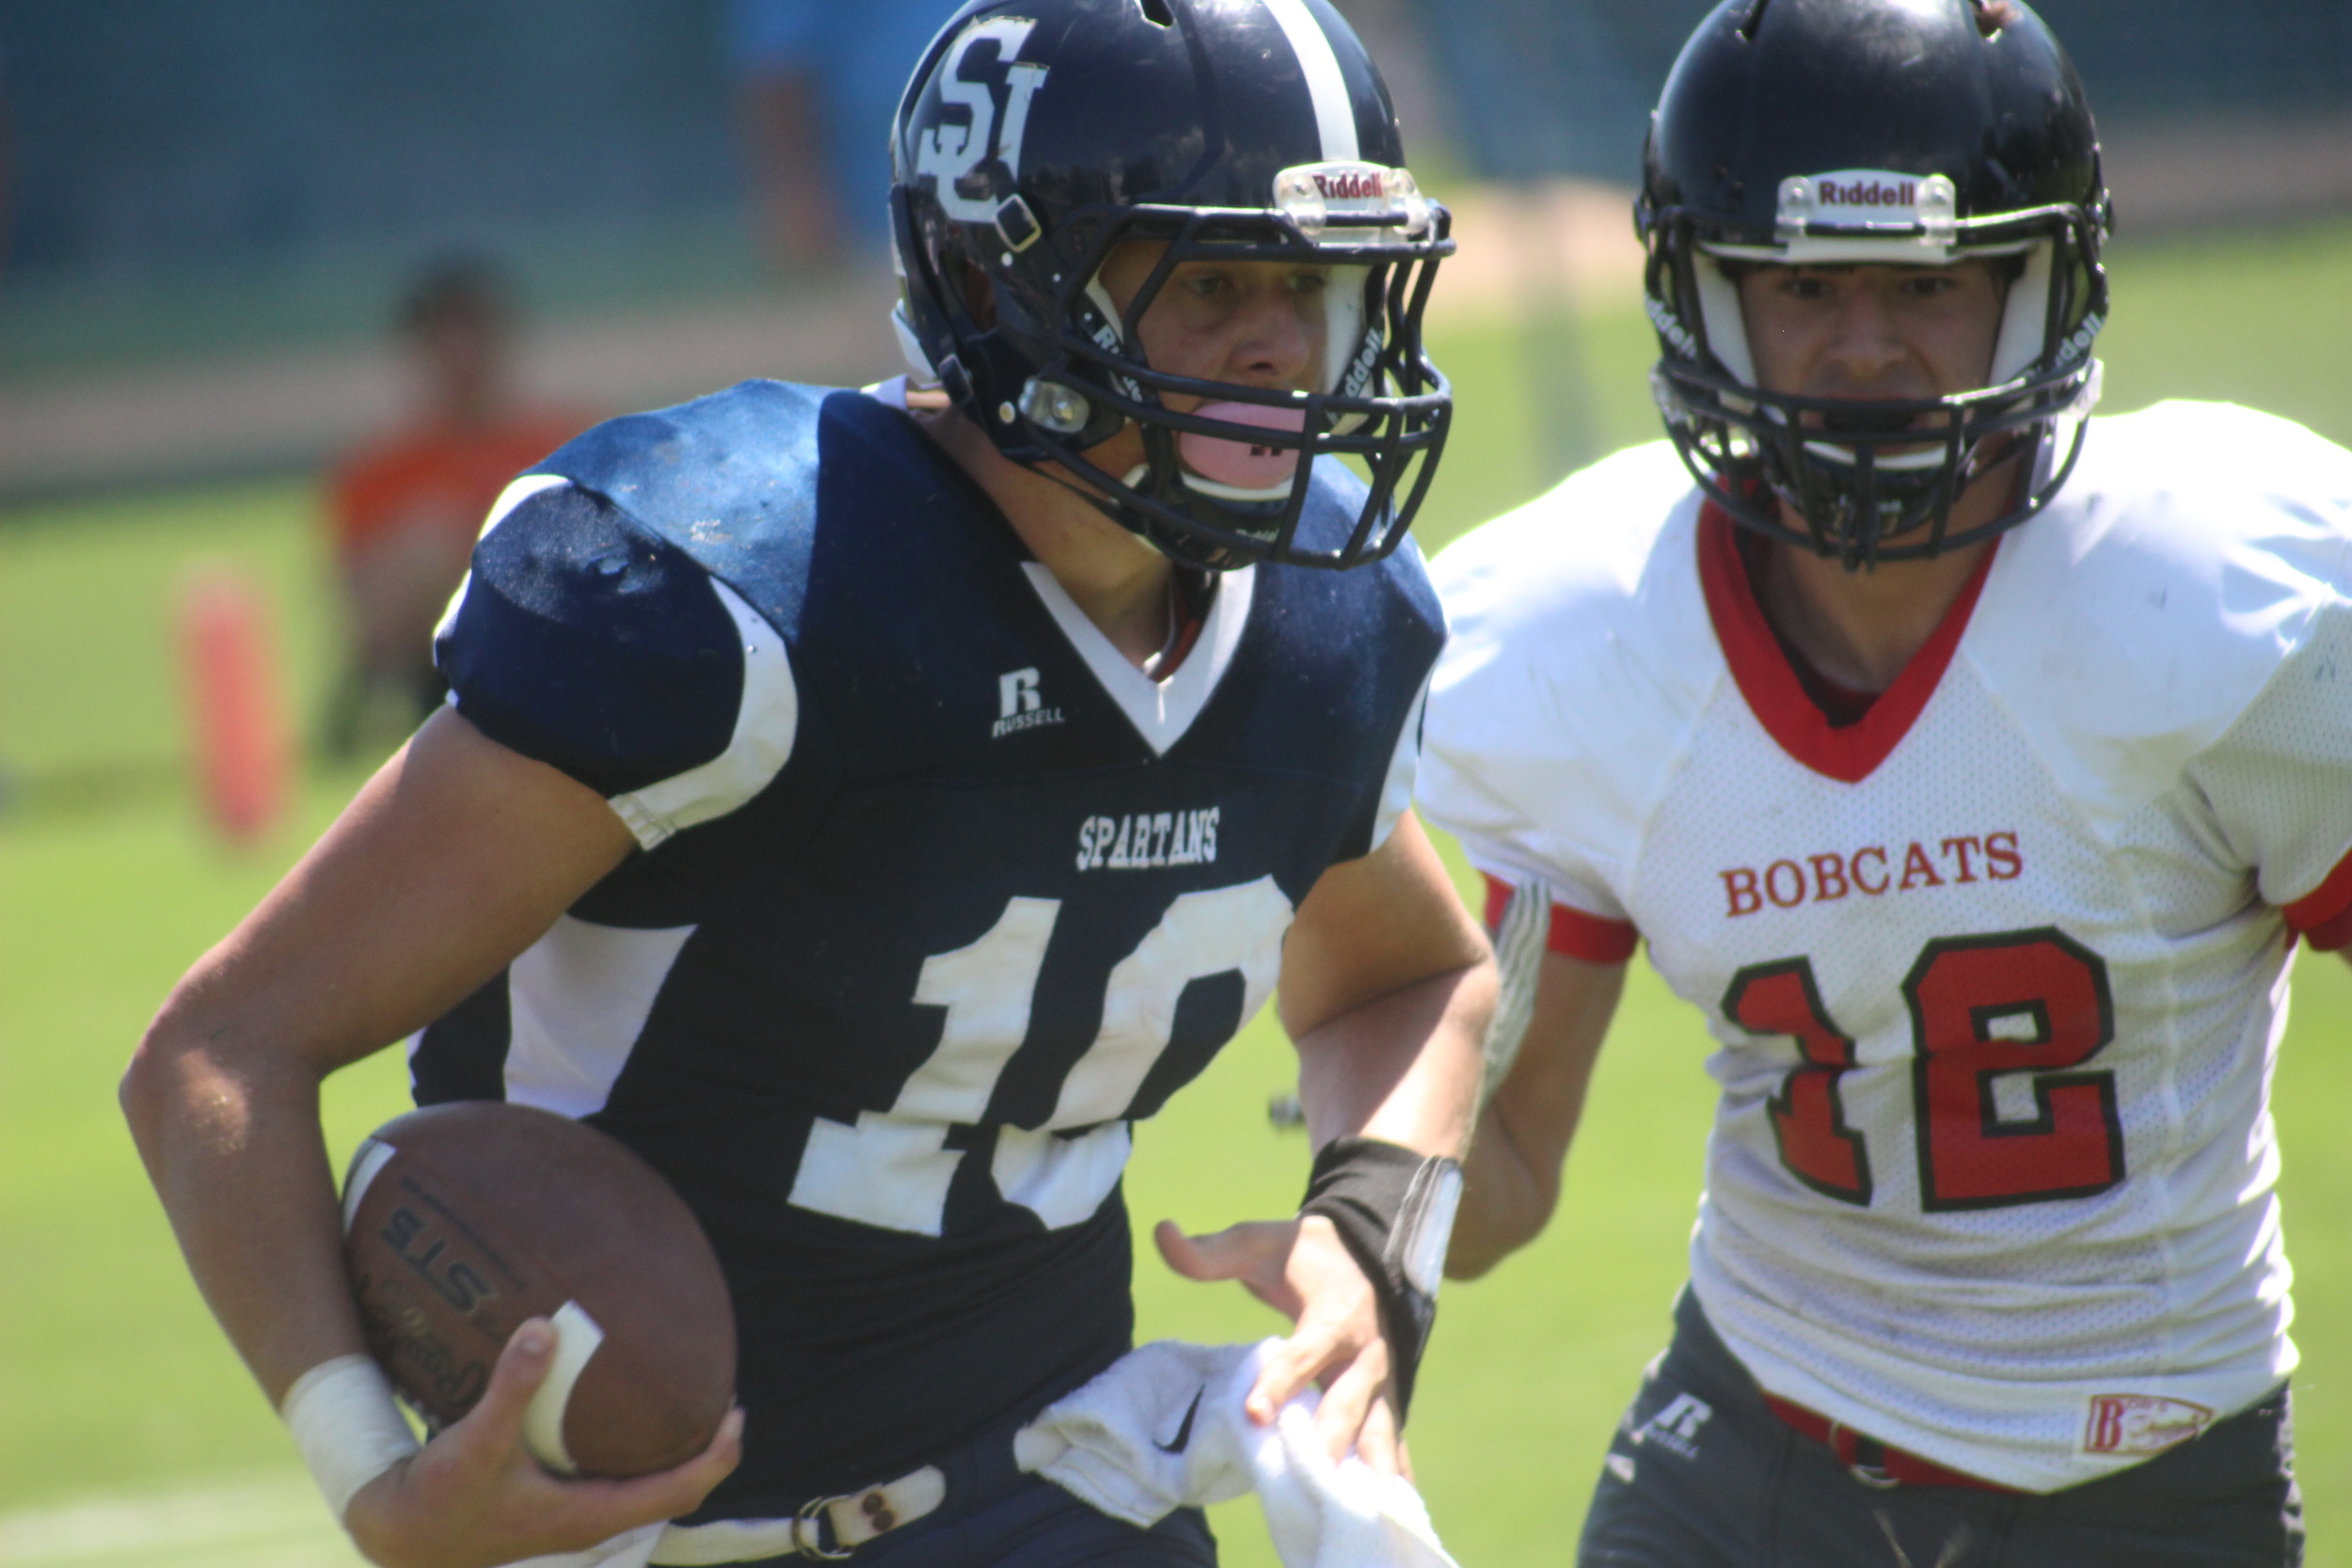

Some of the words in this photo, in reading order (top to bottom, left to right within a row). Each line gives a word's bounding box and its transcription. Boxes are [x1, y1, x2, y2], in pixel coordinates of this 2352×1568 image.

[1313, 172, 1384, 199] Riddell
[1818, 180, 1915, 207] Riddell
[992, 706, 1067, 738] RUSSELL
[999, 666, 1042, 719] R
[1075, 806, 1220, 871] SPARTANS
[1718, 831, 2024, 918] BOBCATS
[787, 874, 1295, 1238] 10
[1720, 924, 2126, 1213] 12
